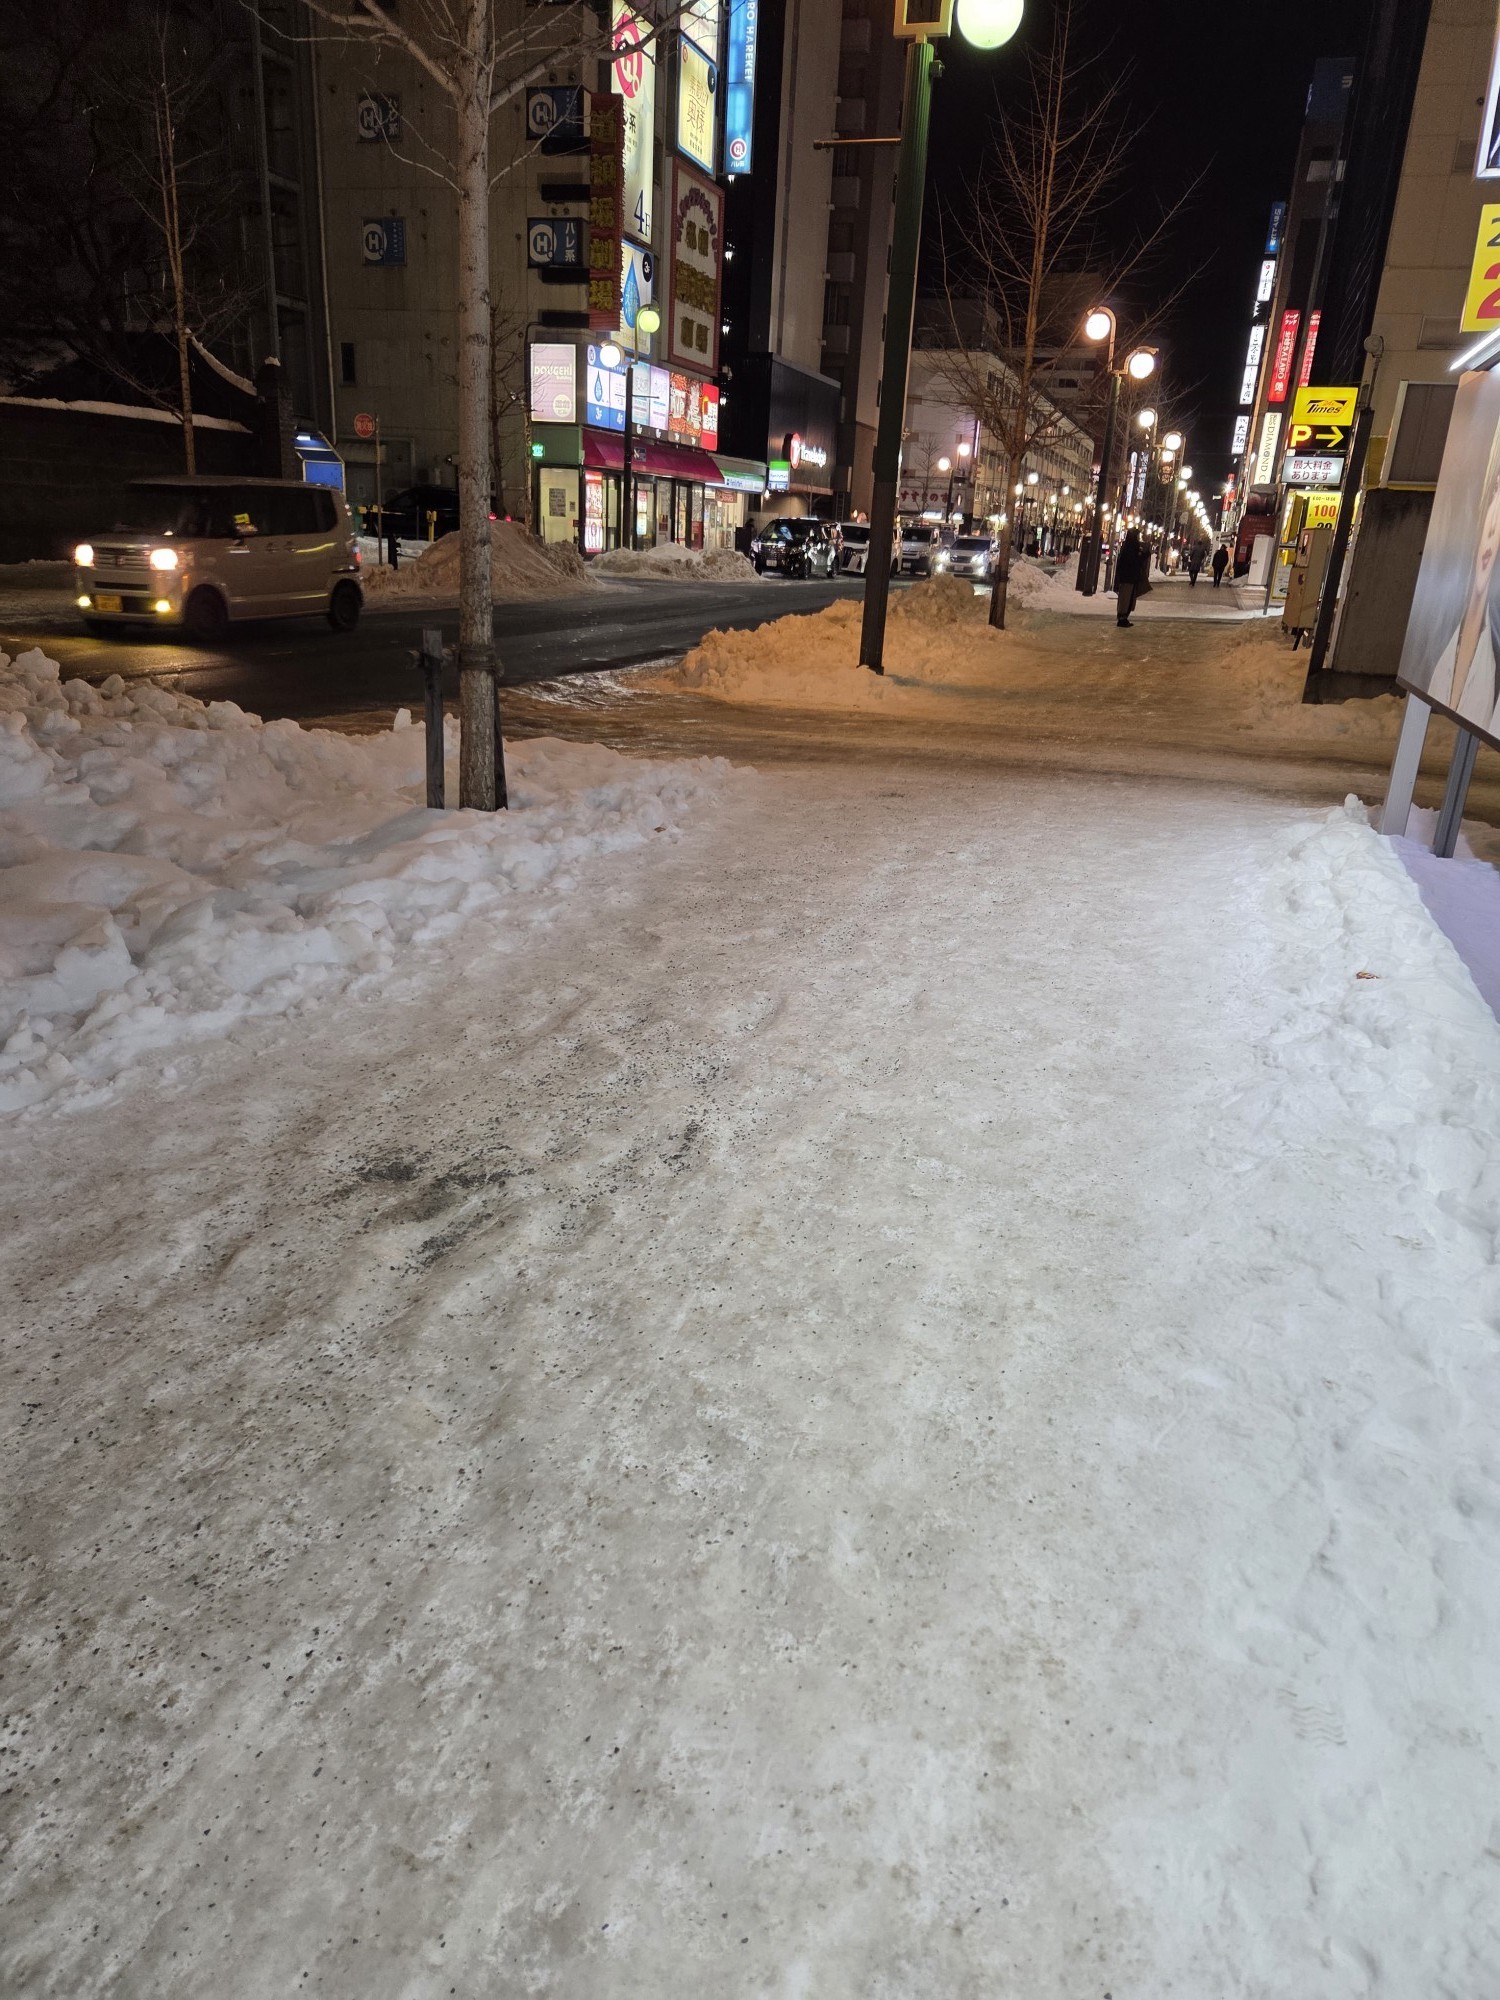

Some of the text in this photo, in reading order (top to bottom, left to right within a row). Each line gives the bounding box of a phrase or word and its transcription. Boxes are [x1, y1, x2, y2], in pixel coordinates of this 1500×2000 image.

[564, 222, 576, 263] ハレ系
[1306, 402, 1342, 414] Times
[1290, 424, 1312, 448] P
[1260, 427, 1276, 472] DIAMOND
[1292, 460, 1332, 470] 最大料金
[1291, 471, 1330, 481] あります
[1314, 504, 1337, 518] 100
